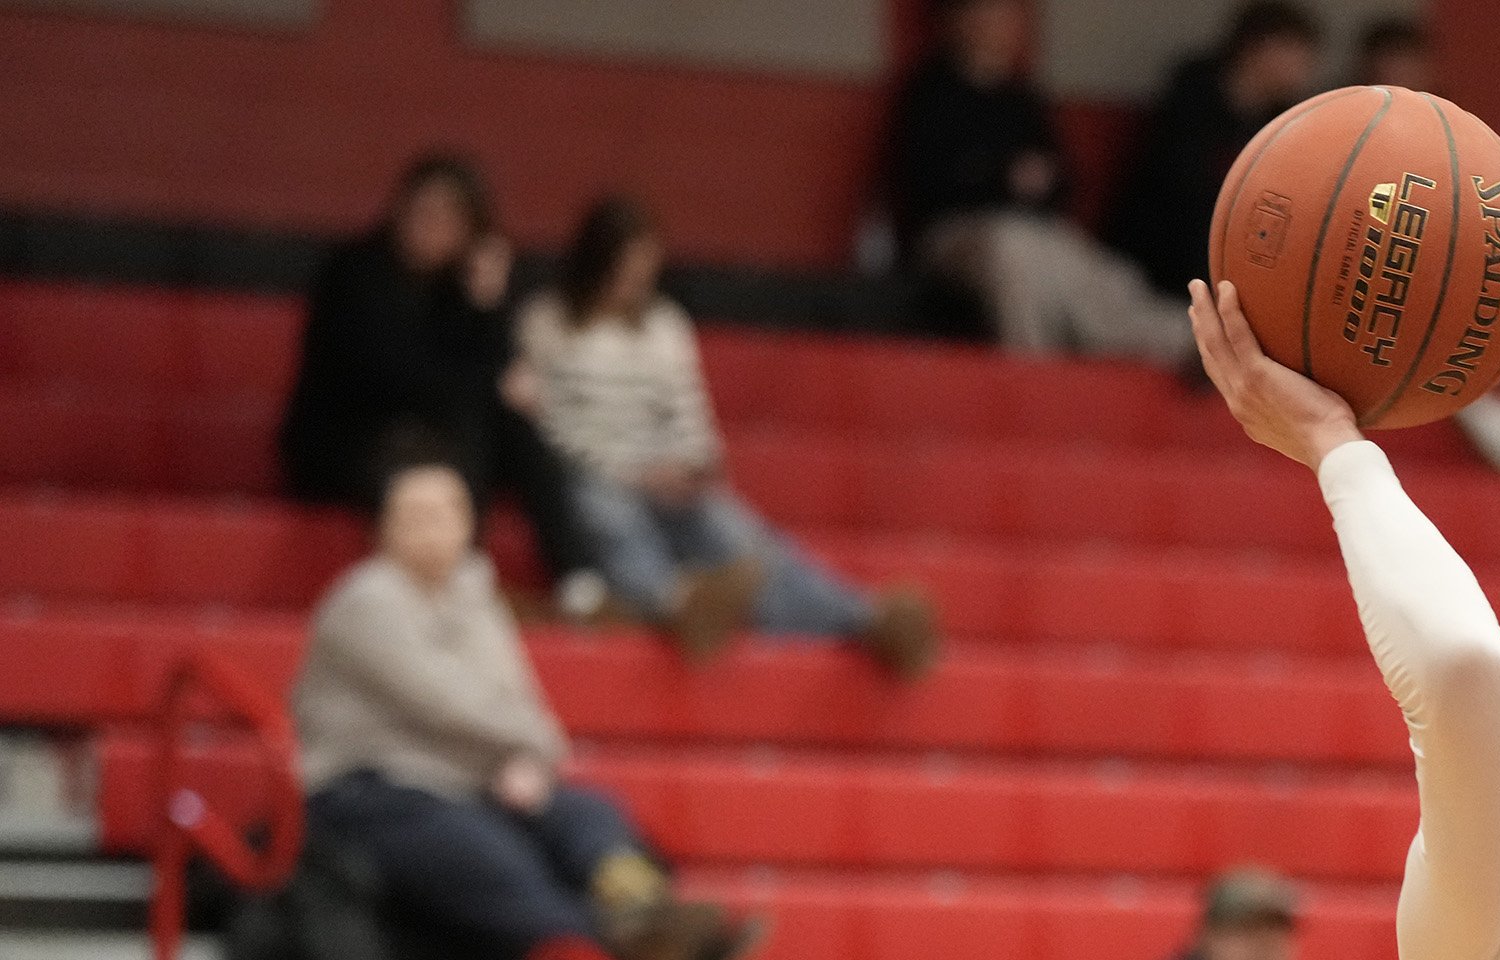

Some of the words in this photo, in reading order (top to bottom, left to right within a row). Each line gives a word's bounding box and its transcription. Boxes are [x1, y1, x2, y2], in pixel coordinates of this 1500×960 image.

[1342, 225, 1385, 344] 1000
[1345, 209, 1365, 252] OFFICIAL
[1360, 172, 1437, 367] LEGACY
